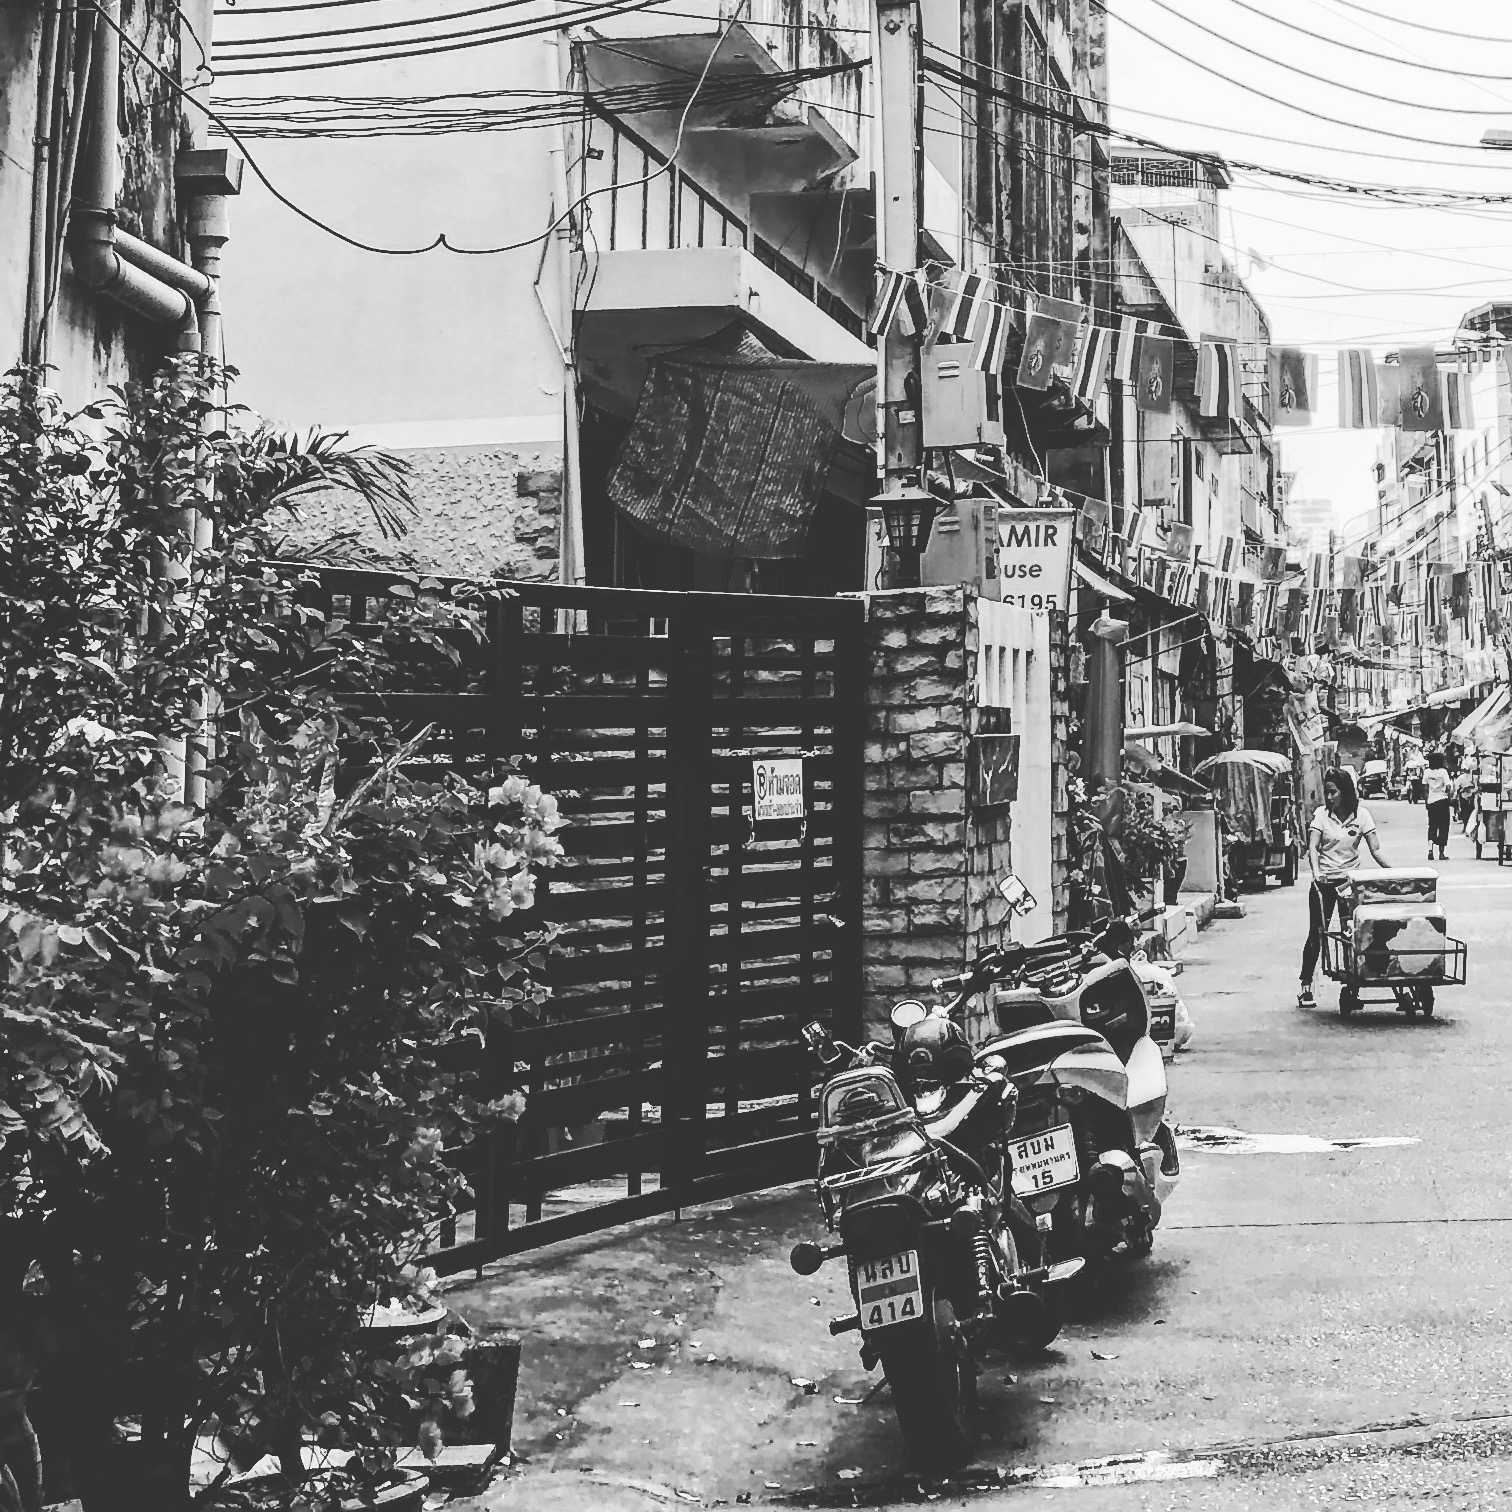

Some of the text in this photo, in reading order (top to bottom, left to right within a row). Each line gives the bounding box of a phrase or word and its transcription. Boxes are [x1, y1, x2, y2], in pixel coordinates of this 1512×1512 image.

[1004, 563, 1043, 579] use
[1031, 1169, 1054, 1189] 15
[868, 1296, 916, 1325] 414
